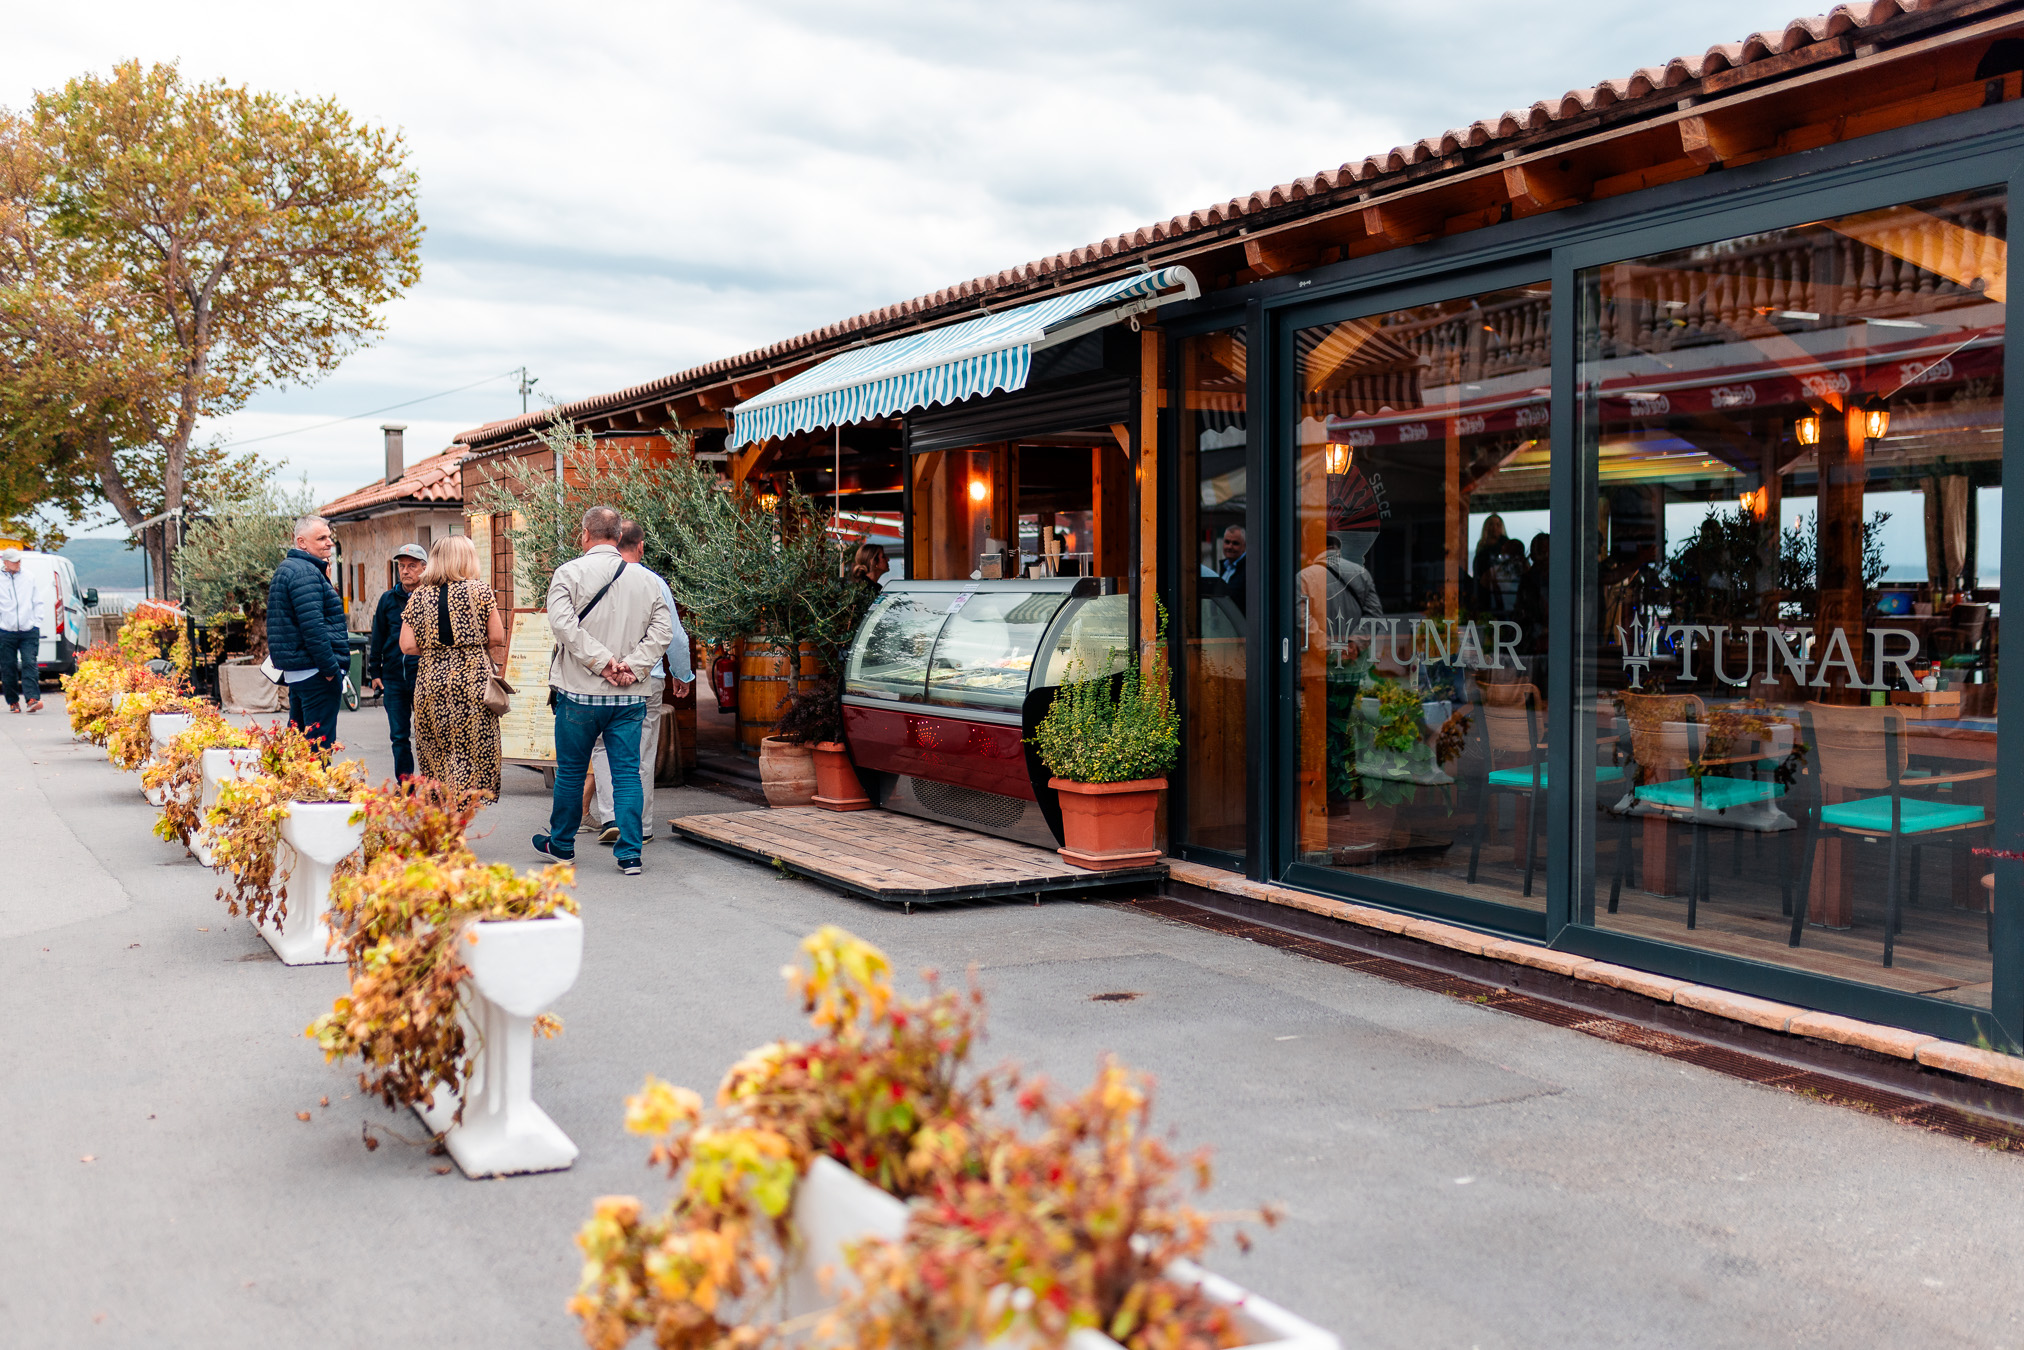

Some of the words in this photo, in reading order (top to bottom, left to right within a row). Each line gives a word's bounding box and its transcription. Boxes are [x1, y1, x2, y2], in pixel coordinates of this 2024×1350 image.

[1368, 472, 1392, 519] SELCE
[1358, 617, 1527, 671] TUNAR
[1664, 625, 1926, 693] TUNAR
